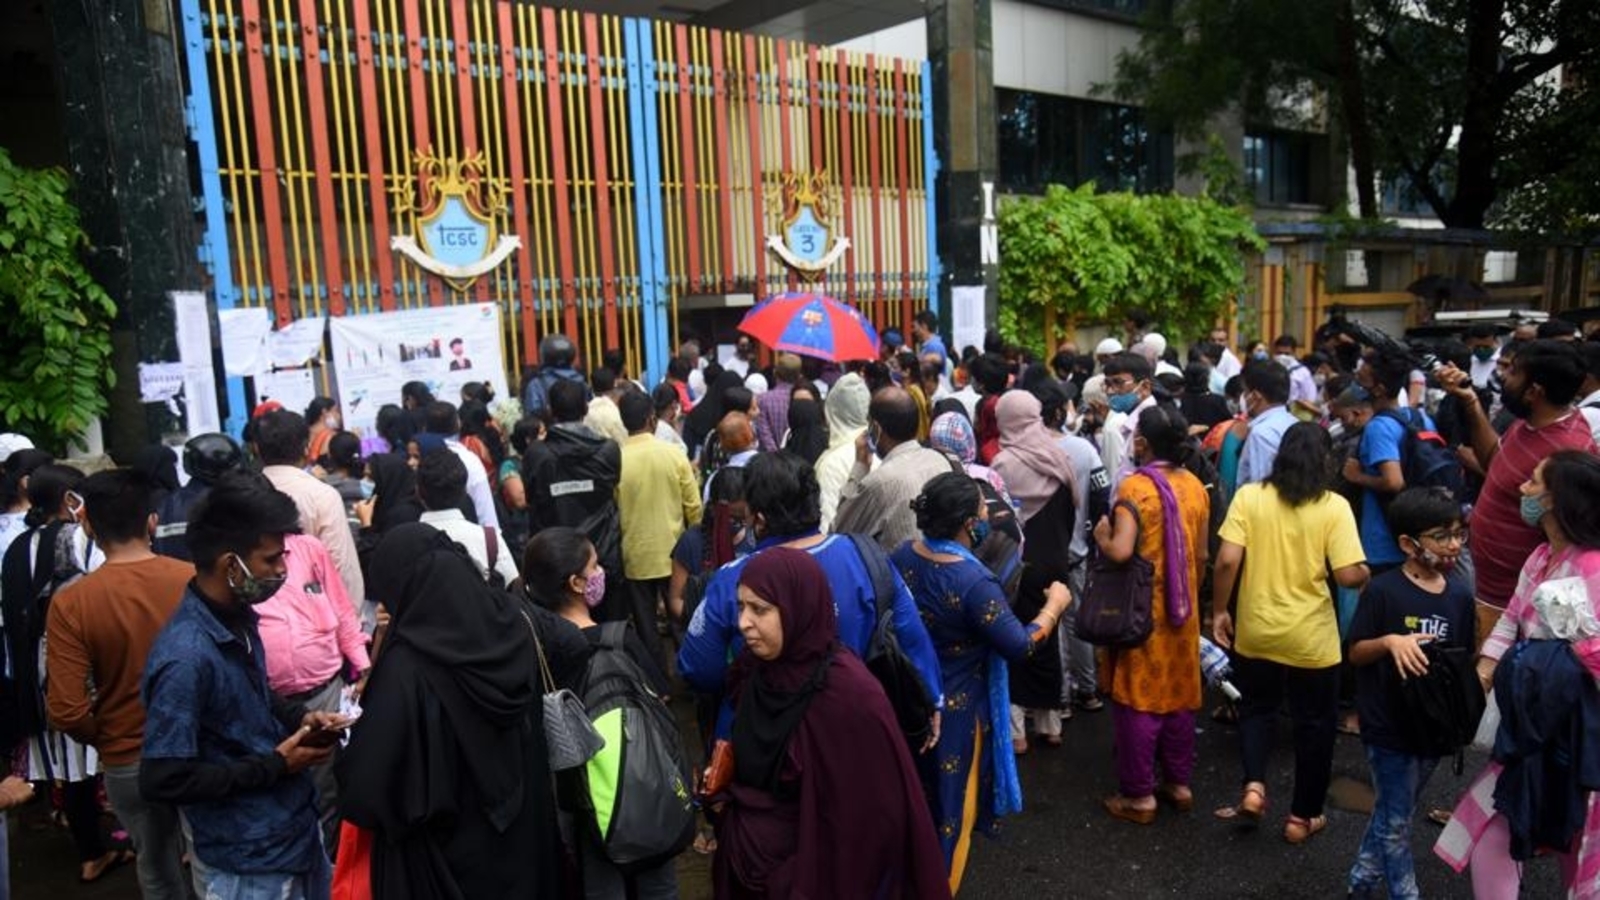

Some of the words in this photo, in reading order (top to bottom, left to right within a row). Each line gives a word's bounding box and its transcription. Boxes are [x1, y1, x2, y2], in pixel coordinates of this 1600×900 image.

[980, 182, 998, 264] IN
[801, 234, 815, 253] 3
[1419, 618, 1449, 637] THE
